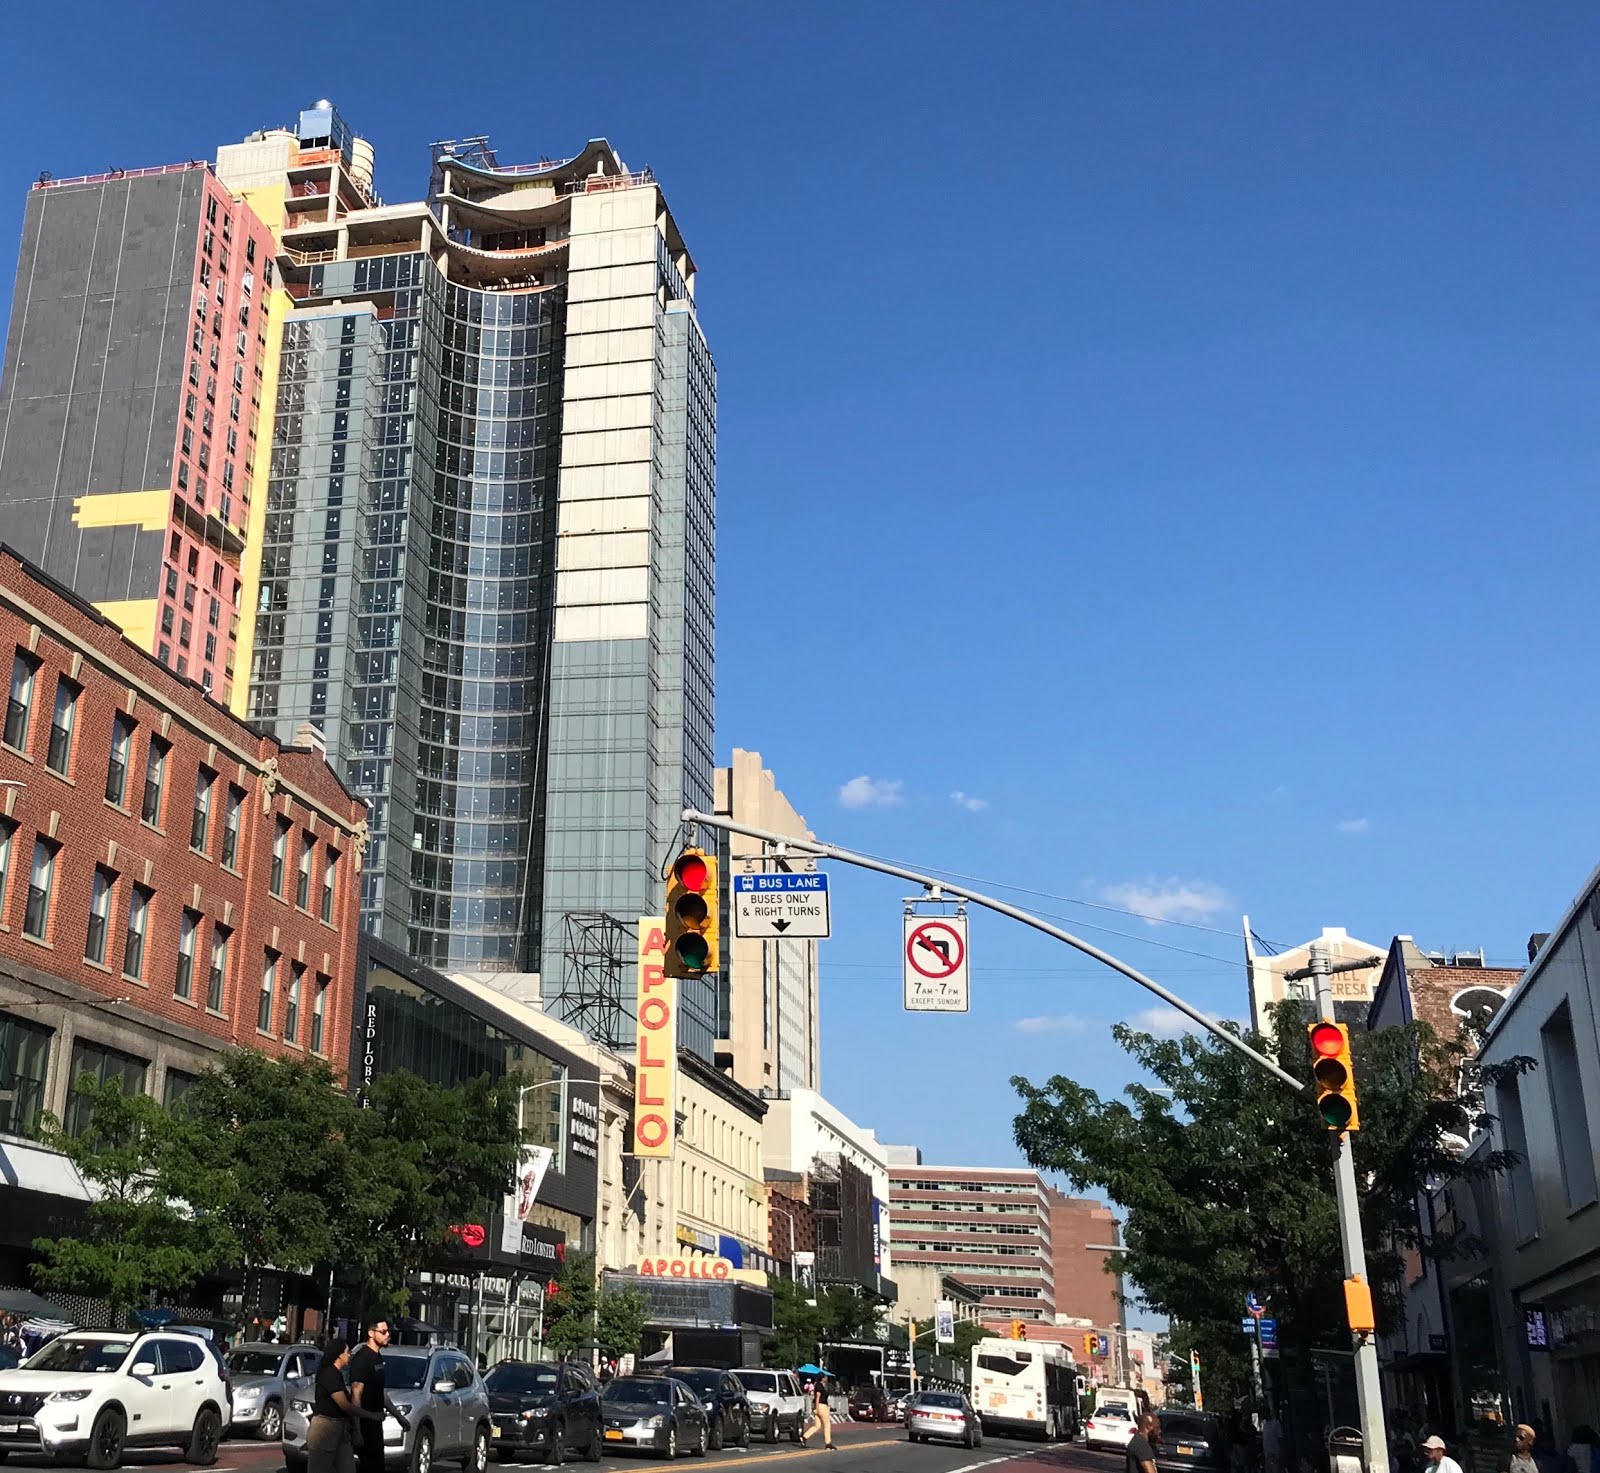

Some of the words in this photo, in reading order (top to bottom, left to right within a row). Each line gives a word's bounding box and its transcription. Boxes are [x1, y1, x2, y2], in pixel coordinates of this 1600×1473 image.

[758, 878, 783, 889] BUS
[787, 877, 821, 888] LANE
[750, 894, 783, 904] BUSES
[785, 893, 810, 904] ONLY
[742, 907, 750, 917] &
[754, 906, 783, 916] RIGHT
[787, 906, 821, 916] TURNS
[366, 1004, 377, 1039] RED
[637, 927, 670, 1148] APOLLO
[363, 1041, 375, 1109] LOBSE
[521, 1234, 534, 1255] RED
[533, 1237, 556, 1260] LOBSTER
[640, 1258, 729, 1280] APOLLO
